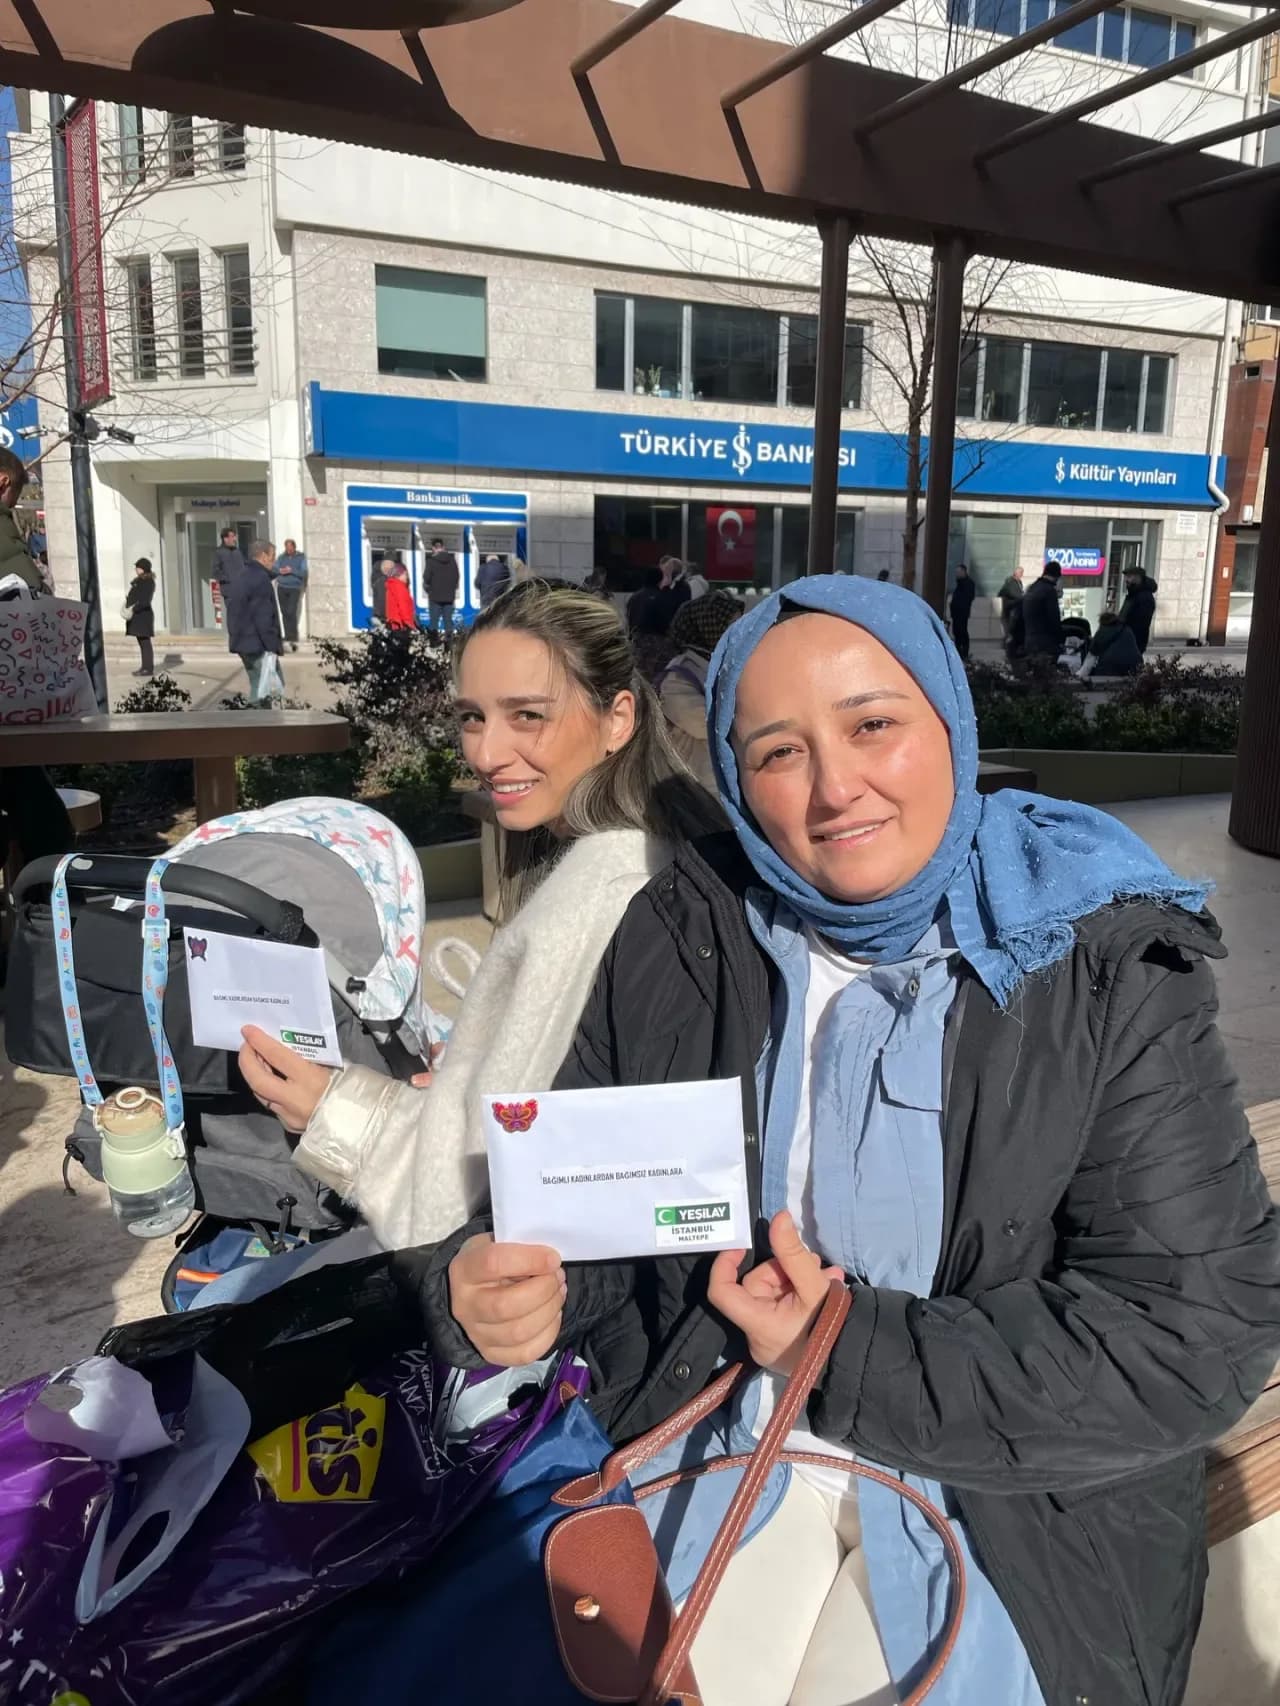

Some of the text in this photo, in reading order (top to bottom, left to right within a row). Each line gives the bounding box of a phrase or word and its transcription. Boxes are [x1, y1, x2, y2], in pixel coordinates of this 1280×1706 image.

[620, 429, 727, 459] TÜRKİYE
[756, 442, 856, 467] BANKSI
[1069, 463, 1116, 482] Kültür
[1118, 465, 1177, 487] Yayınları
[406, 490, 473, 505] Bankamatik
[671, 1225, 715, 1235] İSTANBUL
[678, 1234, 709, 1242] MALTEPE
